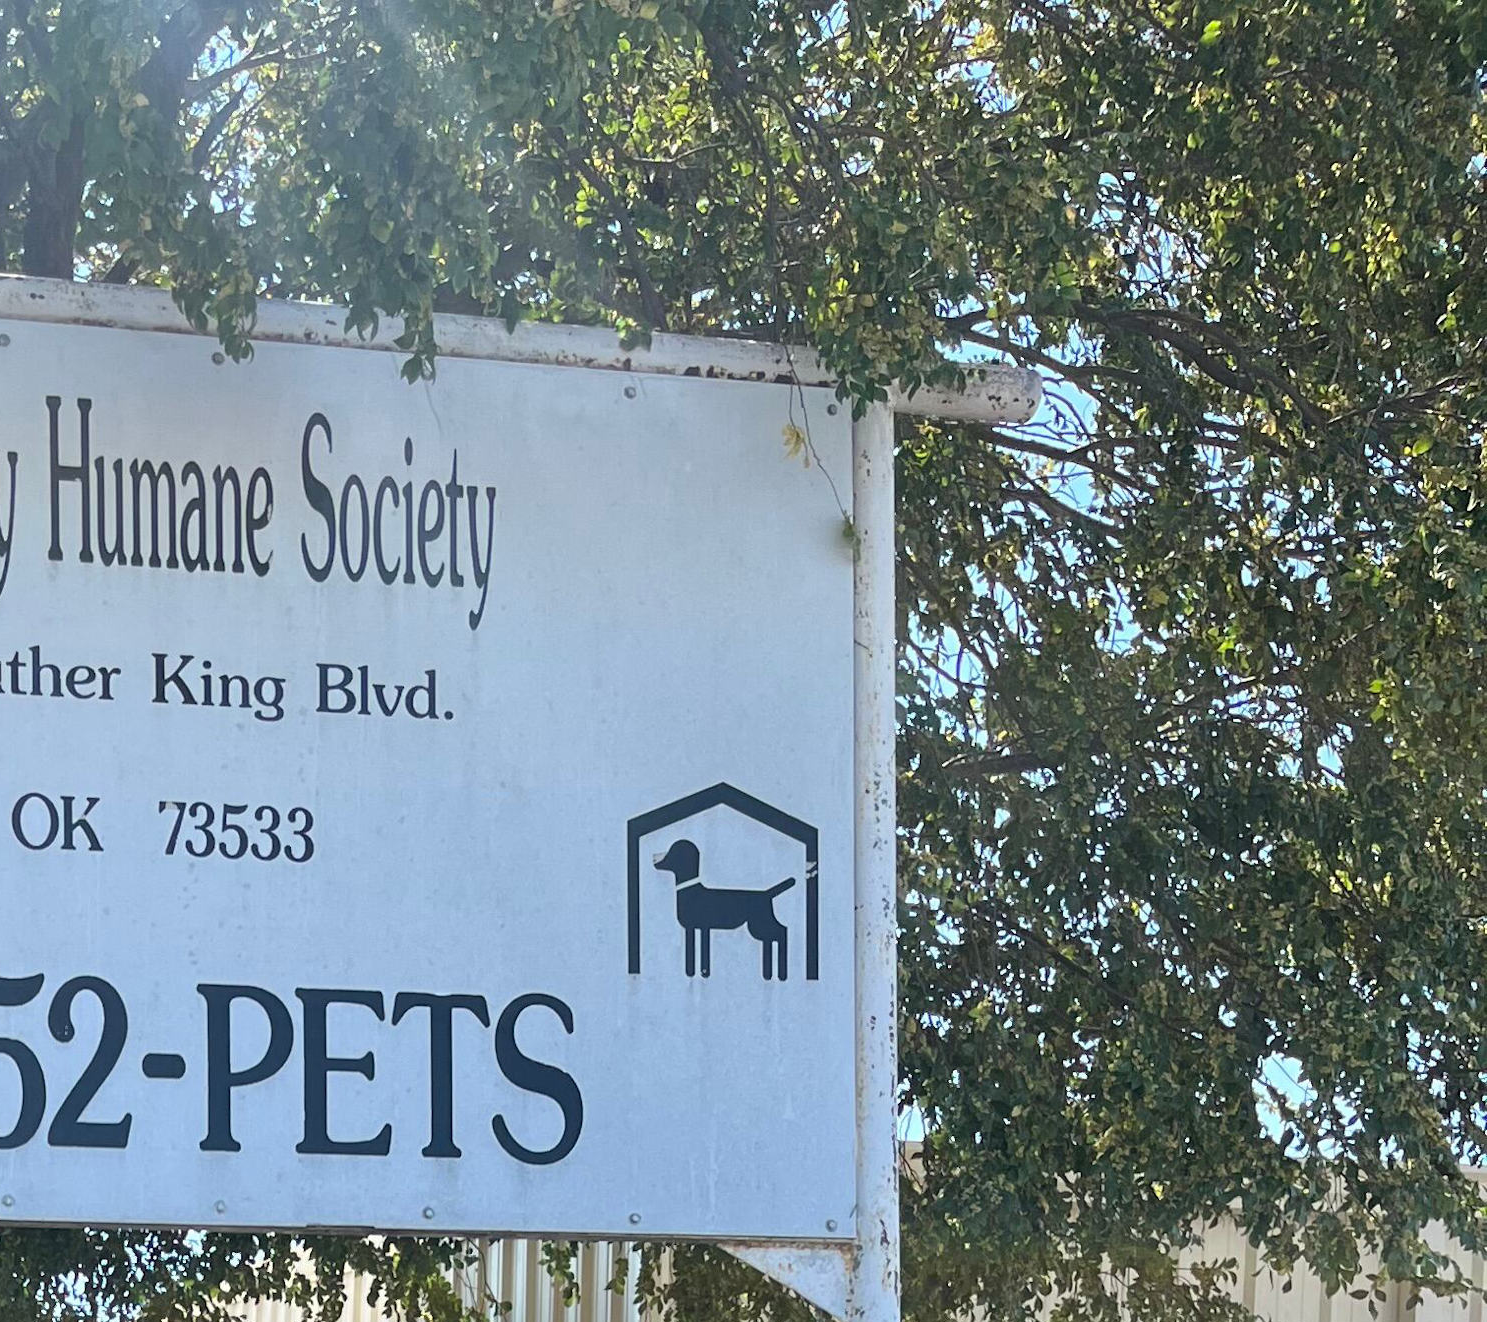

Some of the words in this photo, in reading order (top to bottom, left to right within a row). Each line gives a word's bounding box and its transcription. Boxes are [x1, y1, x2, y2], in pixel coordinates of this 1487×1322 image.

[46, 396, 275, 577] Humane
[301, 412, 499, 631] Society
[152, 653, 287, 722] King
[316, 663, 455, 721] Blvd.
[11, 793, 104, 853] OK
[159, 802, 314, 864] 73533
